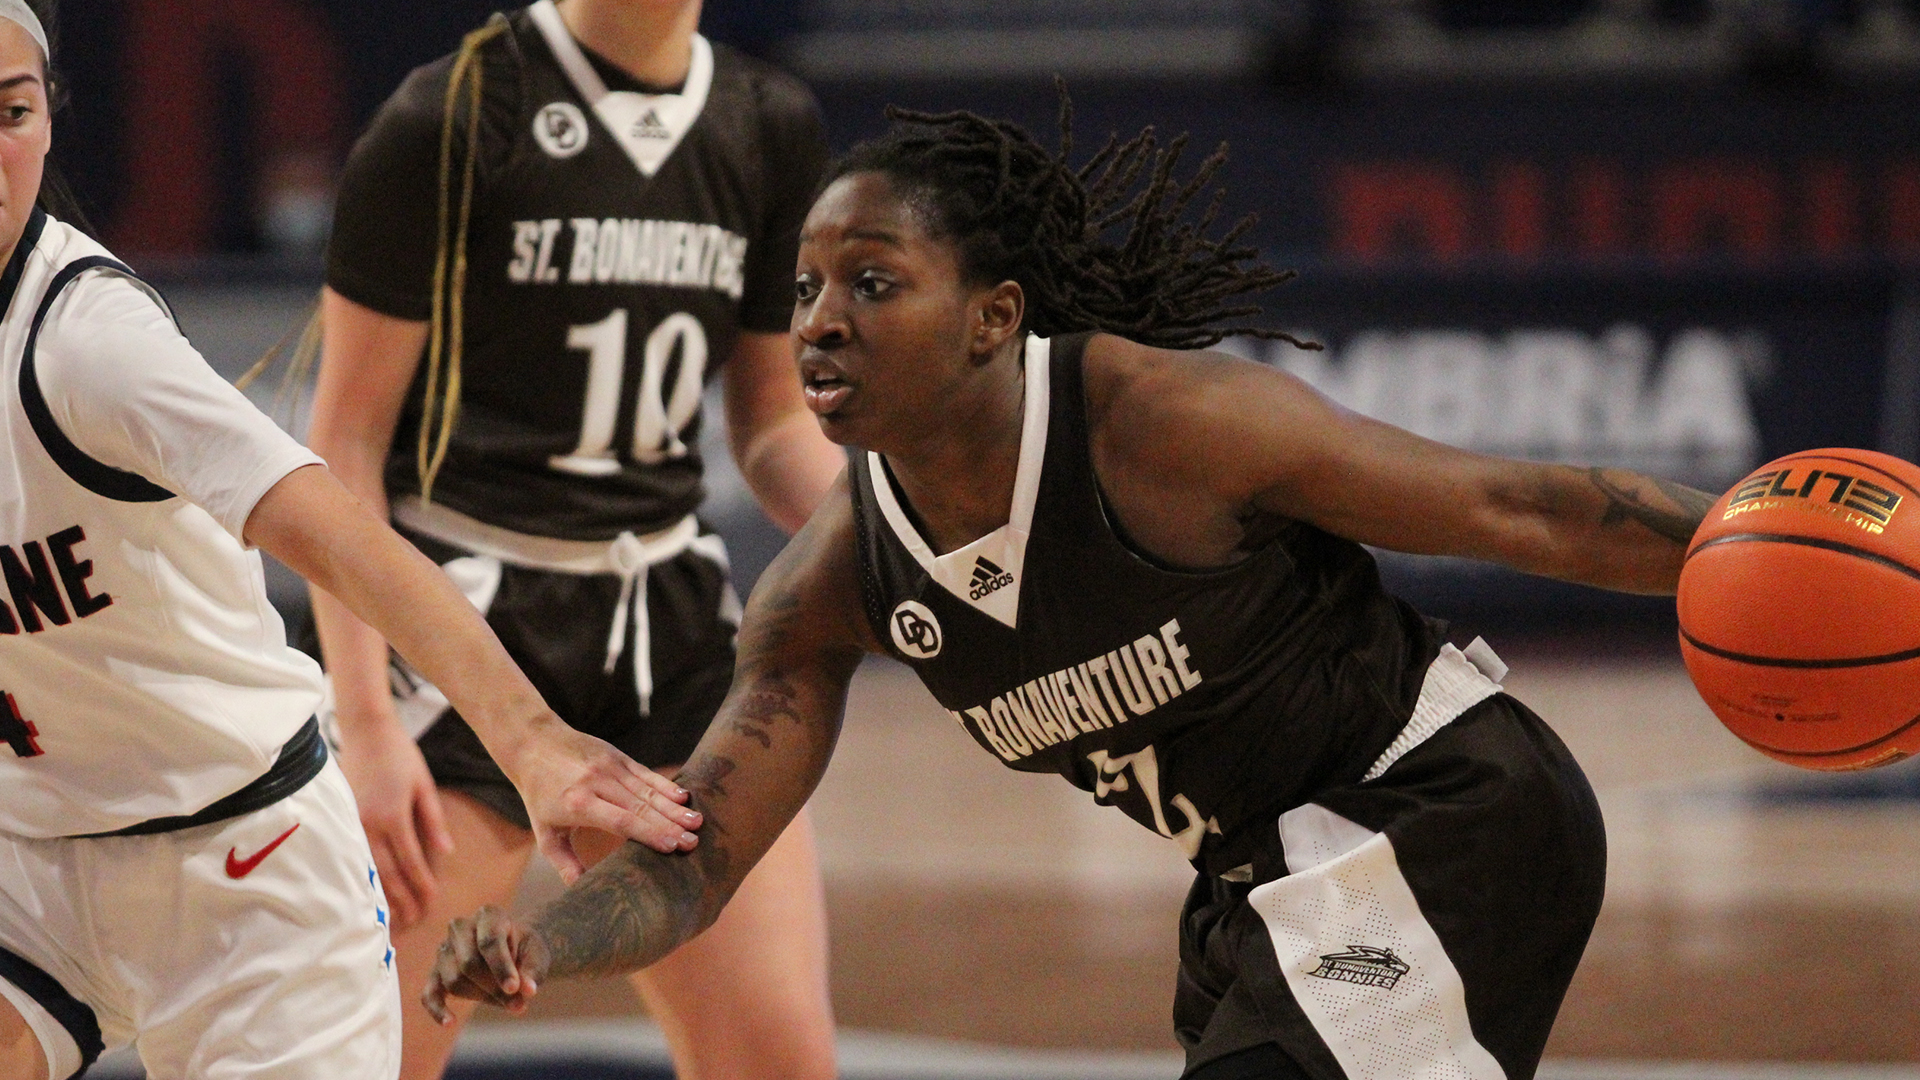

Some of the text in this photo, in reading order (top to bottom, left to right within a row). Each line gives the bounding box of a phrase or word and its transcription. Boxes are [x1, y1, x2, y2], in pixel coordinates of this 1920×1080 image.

[568, 218, 748, 300] BONAVENT
[548, 307, 709, 476] 10
[1722, 501, 1885, 535] CHAMHIP
[1728, 469, 1903, 526] ELITE
[0, 524, 114, 635] NE
[969, 572, 1014, 601] adidas
[964, 618, 1202, 762] BONAVENTURE
[1316, 966, 1396, 989] BONNIES
